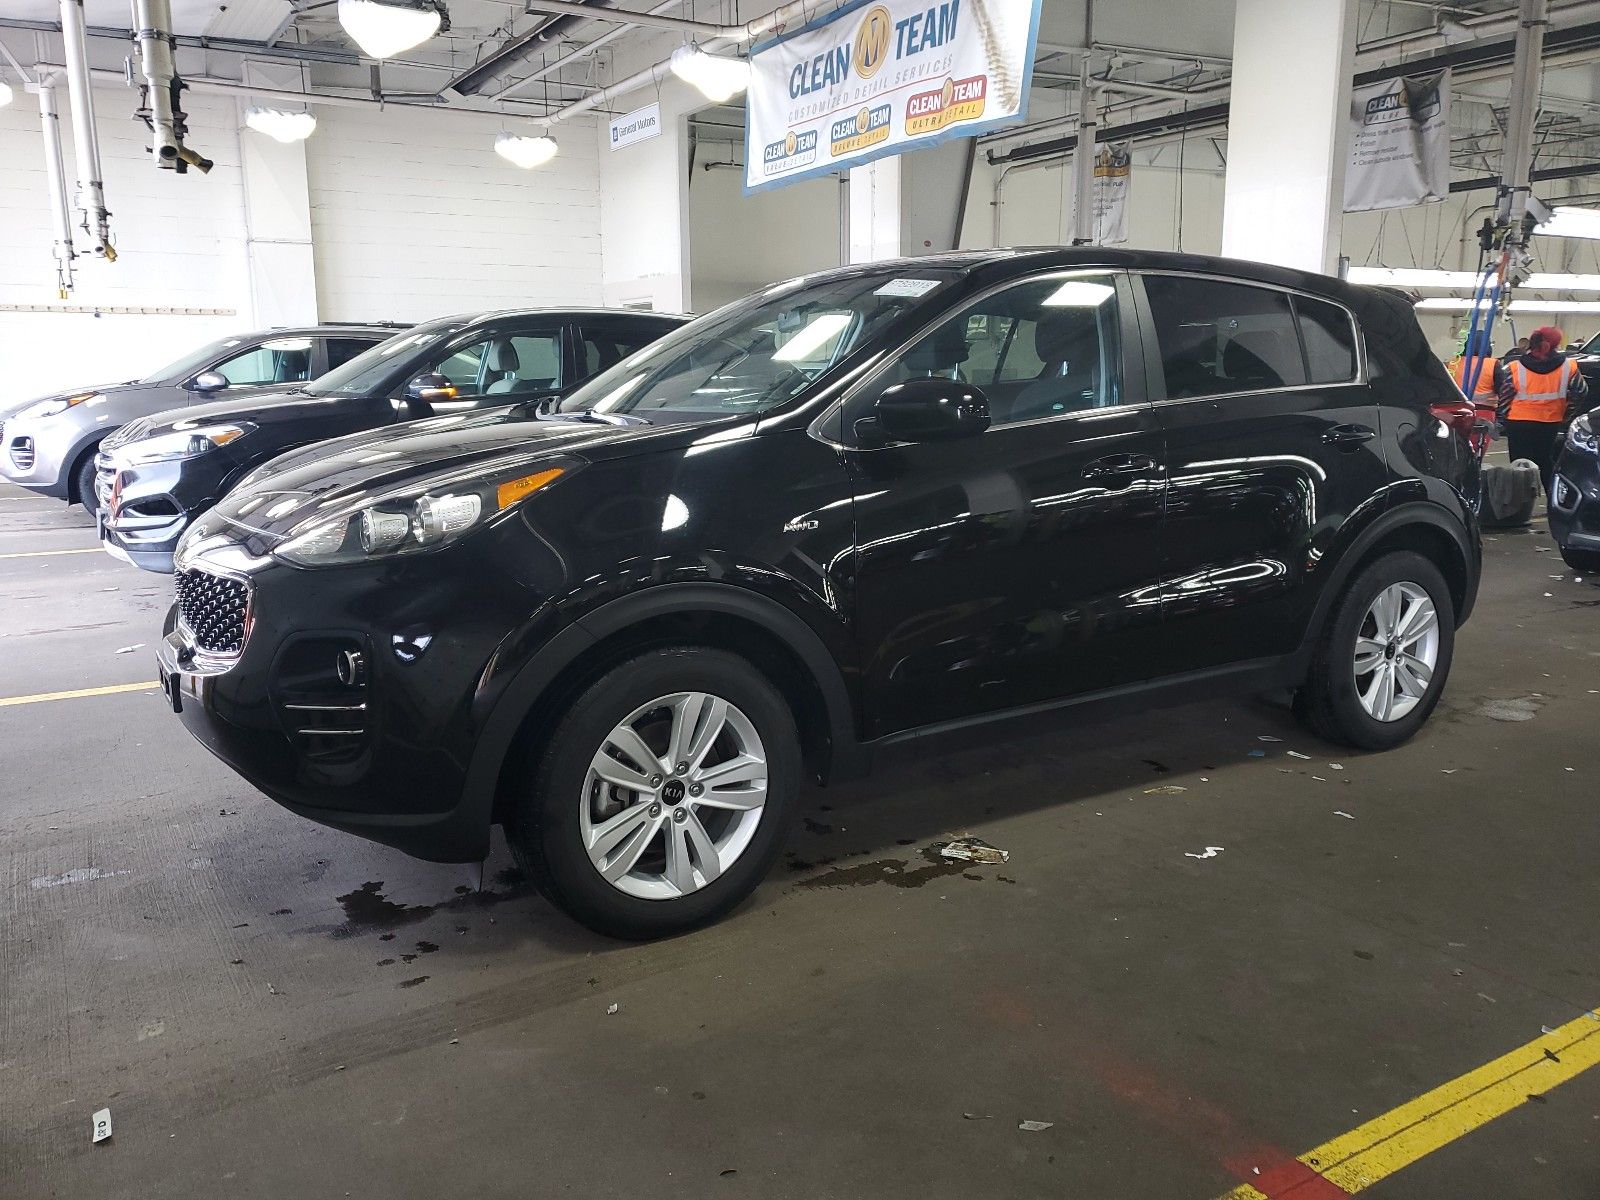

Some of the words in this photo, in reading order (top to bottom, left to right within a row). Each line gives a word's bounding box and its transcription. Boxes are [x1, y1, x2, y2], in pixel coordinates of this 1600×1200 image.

[789, 43, 850, 99] CLEAN
[895, 0, 959, 60] TEAM
[788, 92, 849, 123] CUSTOMIZED
[854, 77, 888, 100] DETAIL
[895, 54, 953, 84] SERVICES
[909, 93, 942, 116] CLEAN
[953, 79, 983, 102] TEAM
[1368, 95, 1399, 113] CLEAN
[619, 121, 637, 137] General
[832, 119, 857, 140] CLEAN
[870, 107, 890, 129] TEAM
[765, 143, 786, 161] CLEAN
[797, 133, 816, 152] TEAM
[665, 787, 683, 798] KIA
